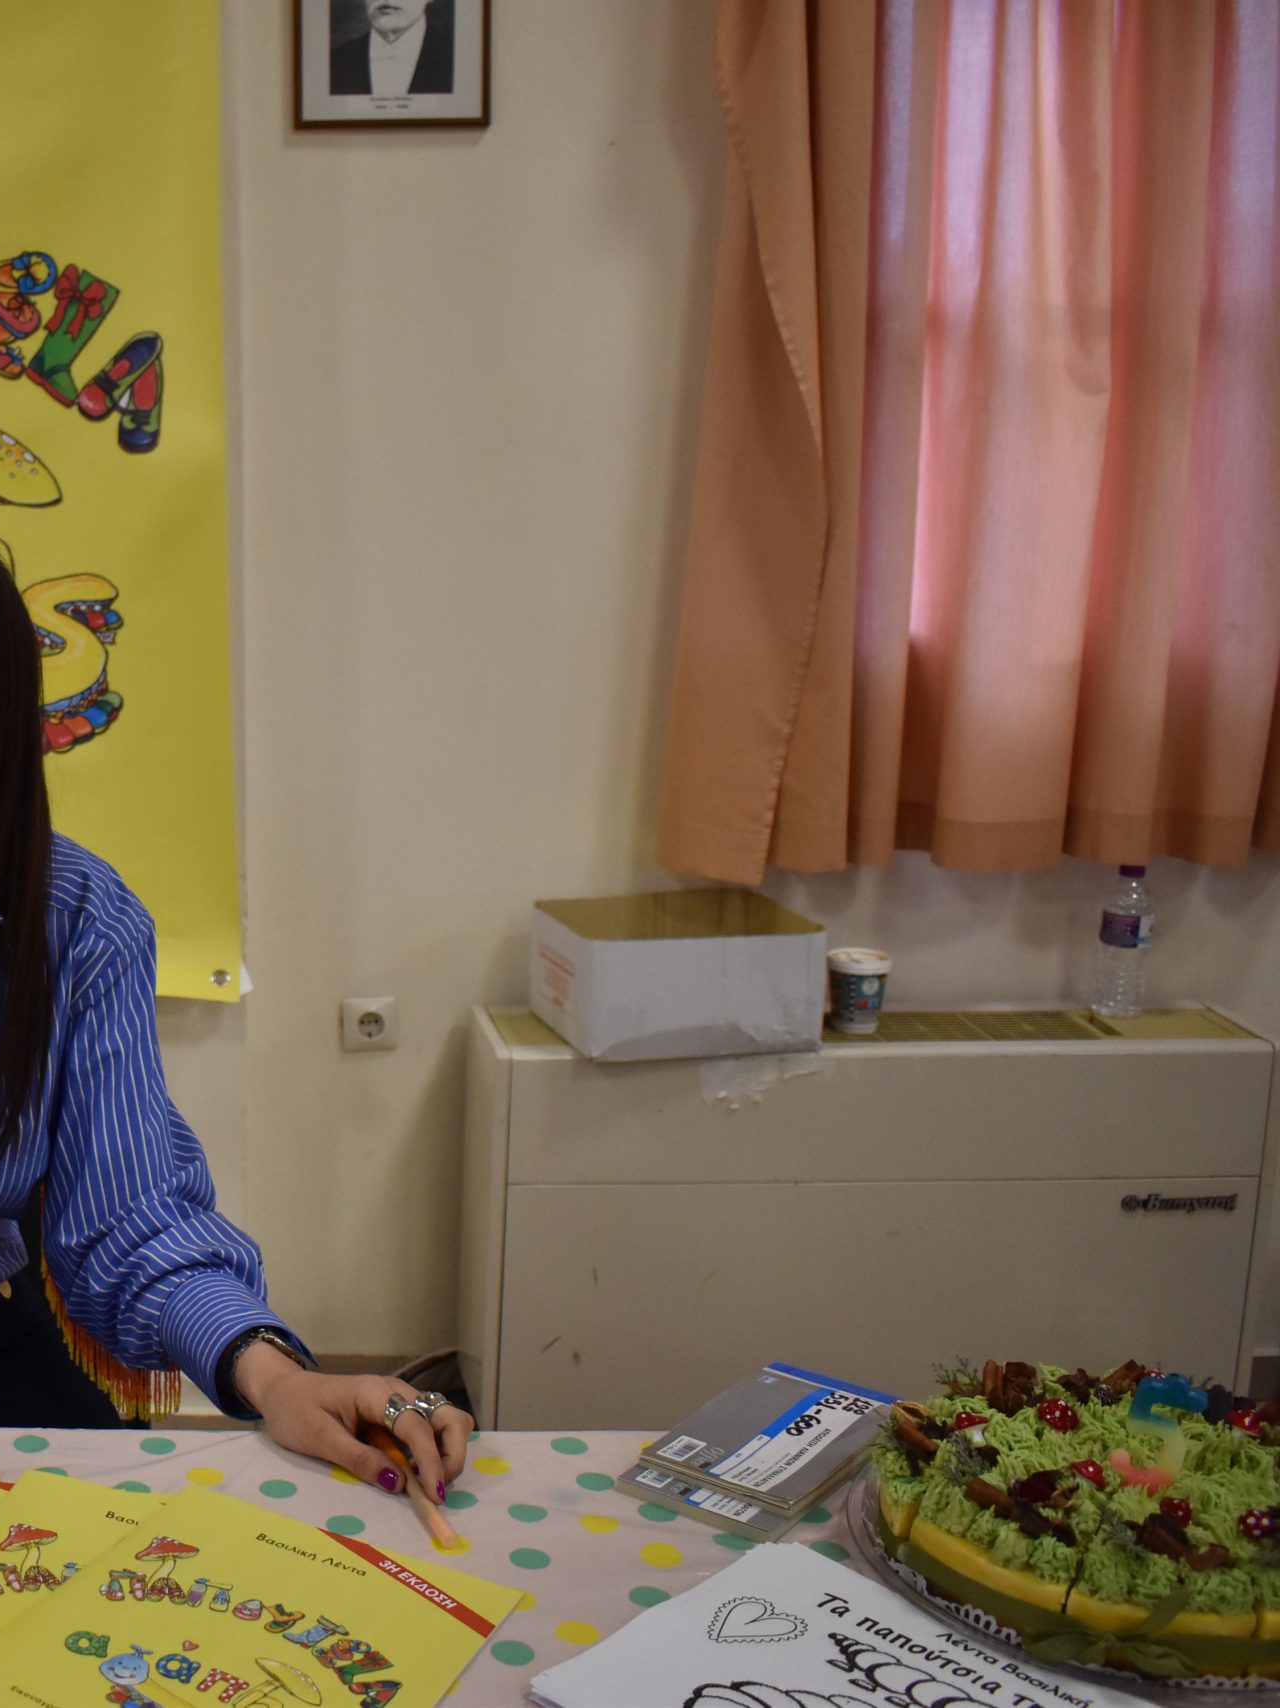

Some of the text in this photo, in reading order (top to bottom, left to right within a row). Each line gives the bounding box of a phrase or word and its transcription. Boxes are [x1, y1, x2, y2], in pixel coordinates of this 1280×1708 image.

[255, 1532, 367, 1577] Βασιλική Λέντα
[378, 1559, 458, 1609] 3Η ΕΚΔΟΣΗ
[816, 1593, 851, 1617] Τα
[856, 1616, 1003, 1695] παπούτσια
[936, 1631, 1094, 1708] Λέντα Βασιλική
